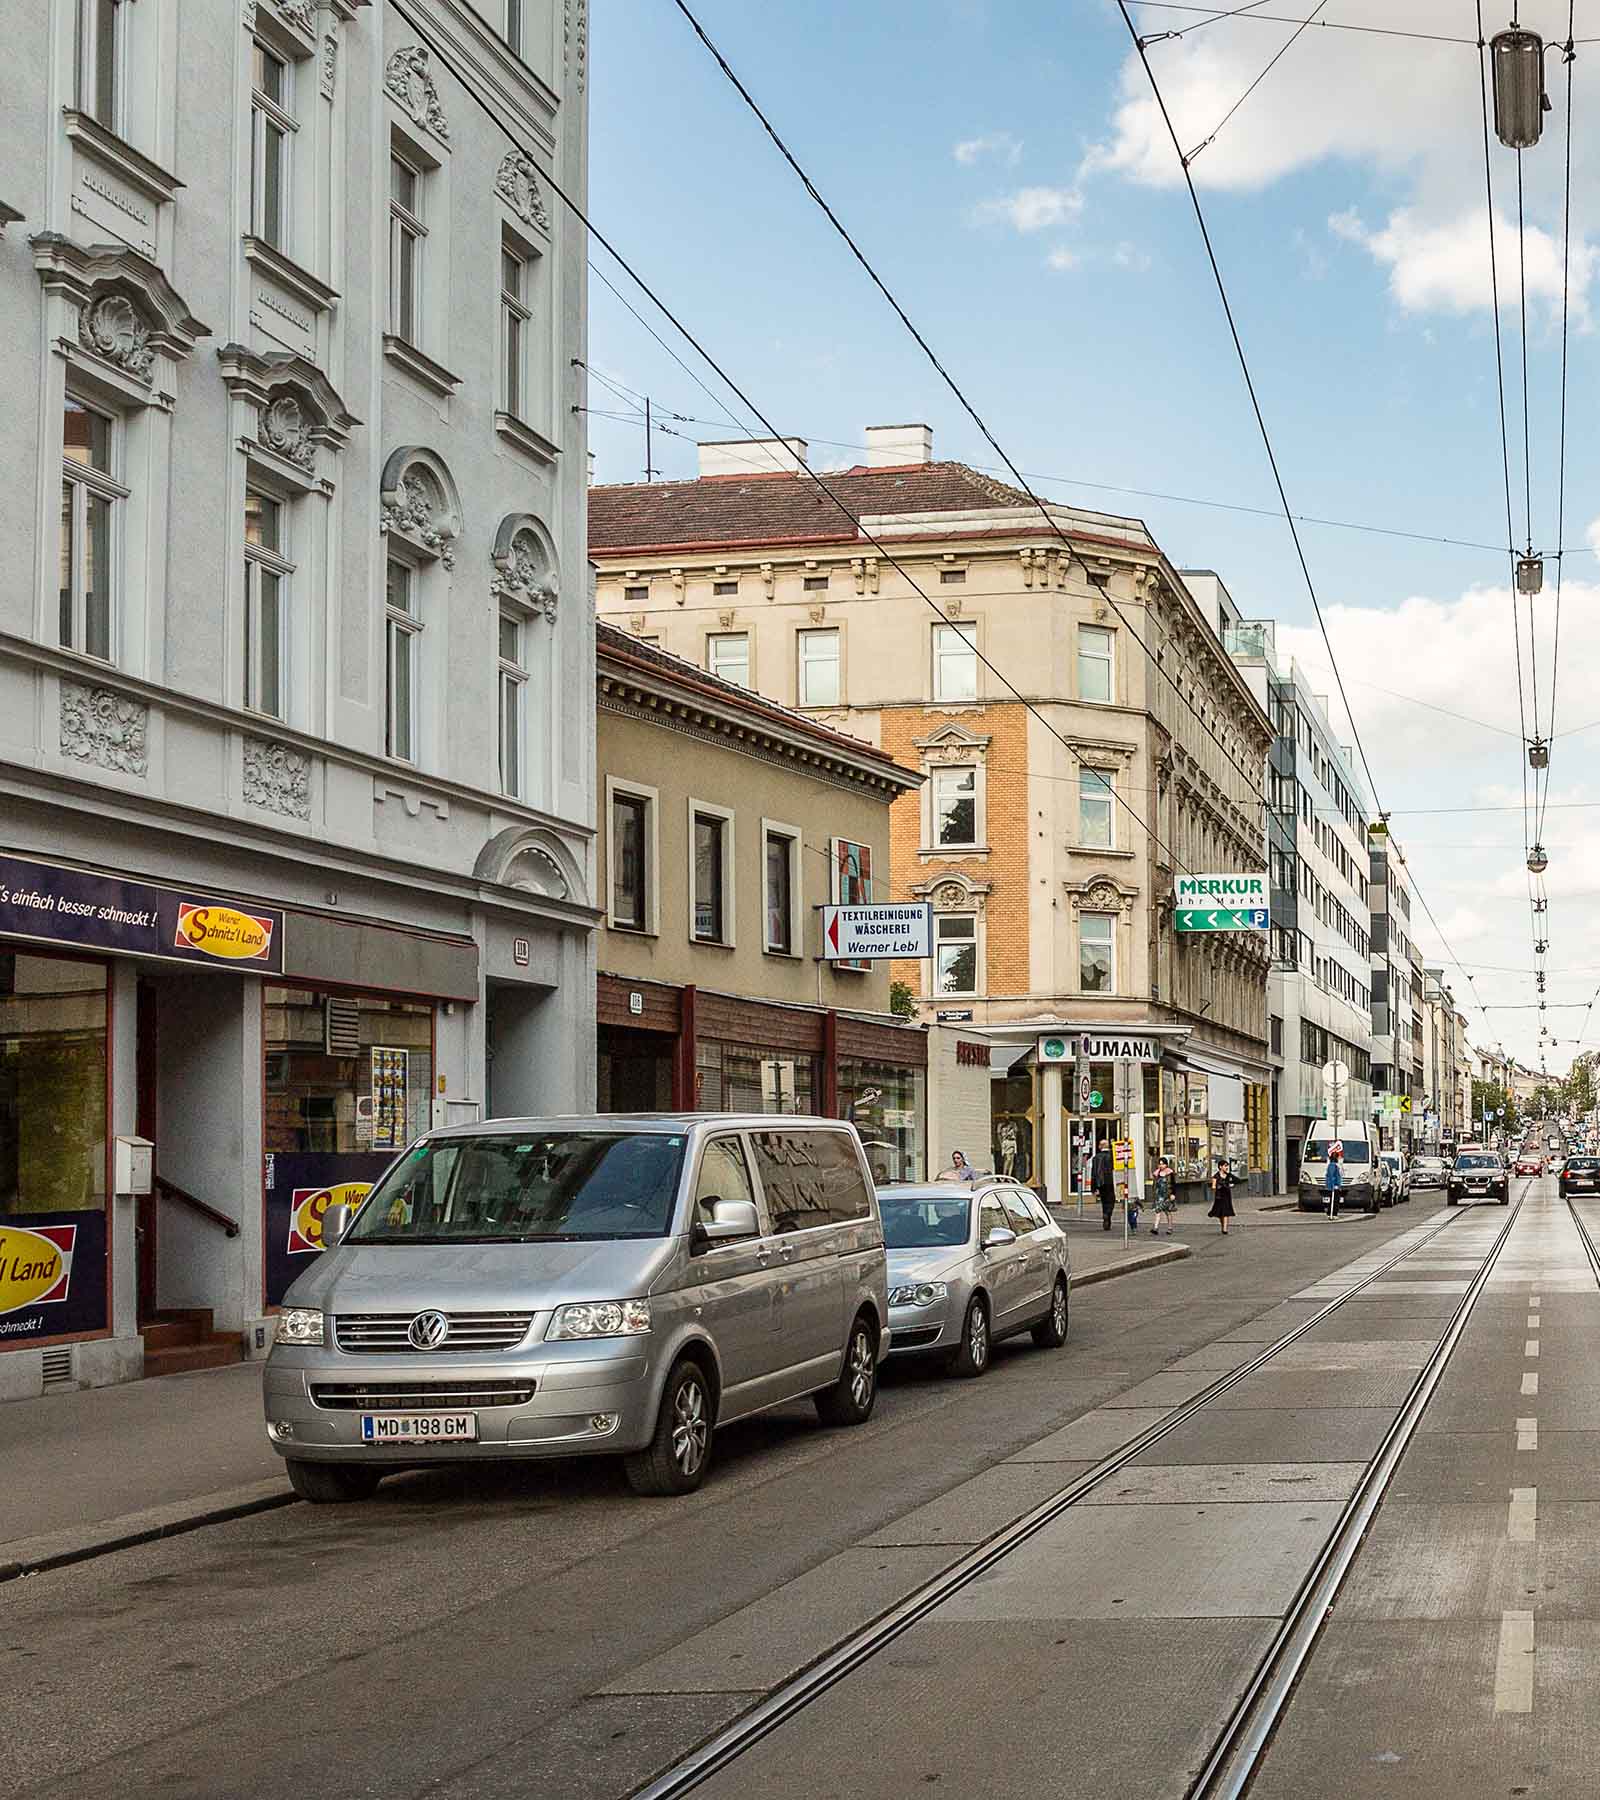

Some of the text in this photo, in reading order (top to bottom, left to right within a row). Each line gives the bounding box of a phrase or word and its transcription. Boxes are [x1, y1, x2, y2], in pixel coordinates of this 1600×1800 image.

[1180, 879, 1263, 895] MERKUR
[11, 889, 54, 911] einfach
[58, 896, 97, 917] besser
[98, 905, 149, 926] schmeckt
[1217, 897, 1264, 905] Markt
[842, 909, 923, 921] TEXTILREINIGUNG
[242, 929, 264, 945] Land
[855, 923, 910, 935] WÄSCHEREI
[848, 940, 919, 953] Werner Lebl
[11, 1254, 58, 1281] Land
[377, 1418, 468, 1436] MD 198 GM
